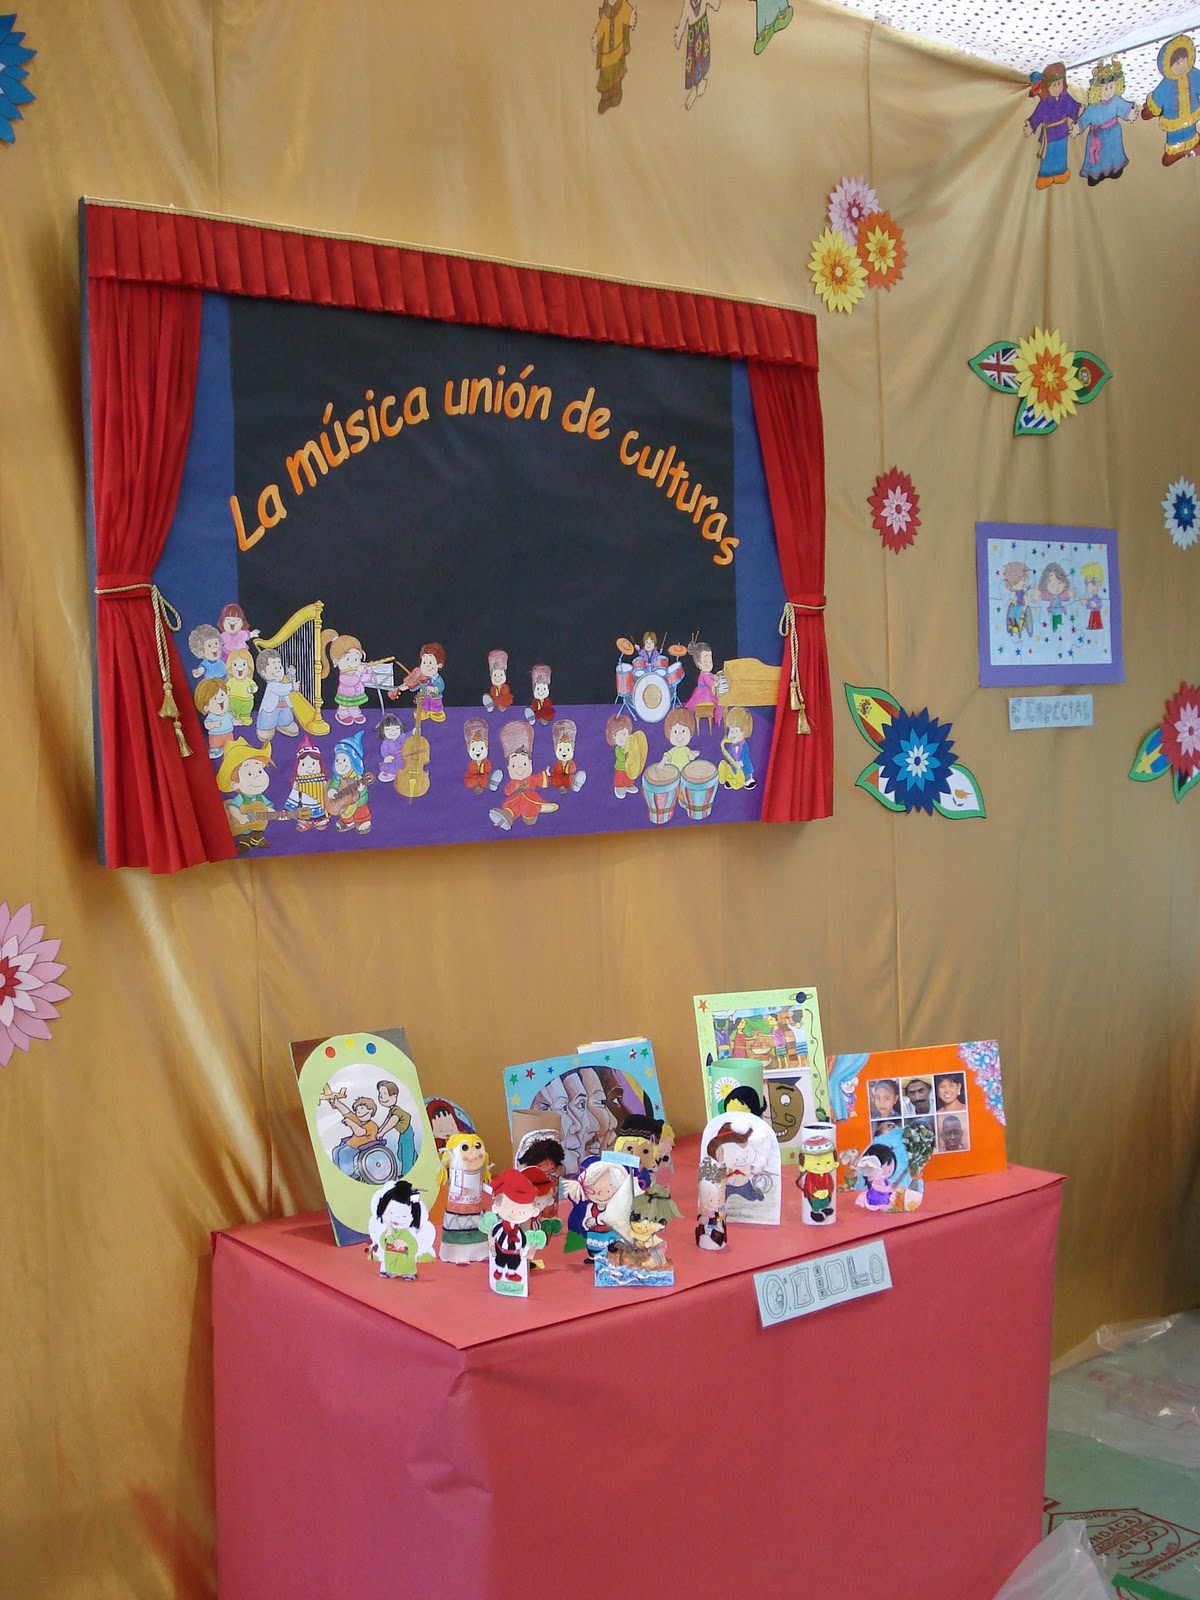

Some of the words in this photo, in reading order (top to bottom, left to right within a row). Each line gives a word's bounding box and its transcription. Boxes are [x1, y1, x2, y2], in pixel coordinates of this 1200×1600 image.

[229, 484, 288, 552] La
[286, 386, 430, 496] música
[444, 364, 552, 420] unión
[561, 387, 611, 441] de
[619, 429, 739, 567] culturas
